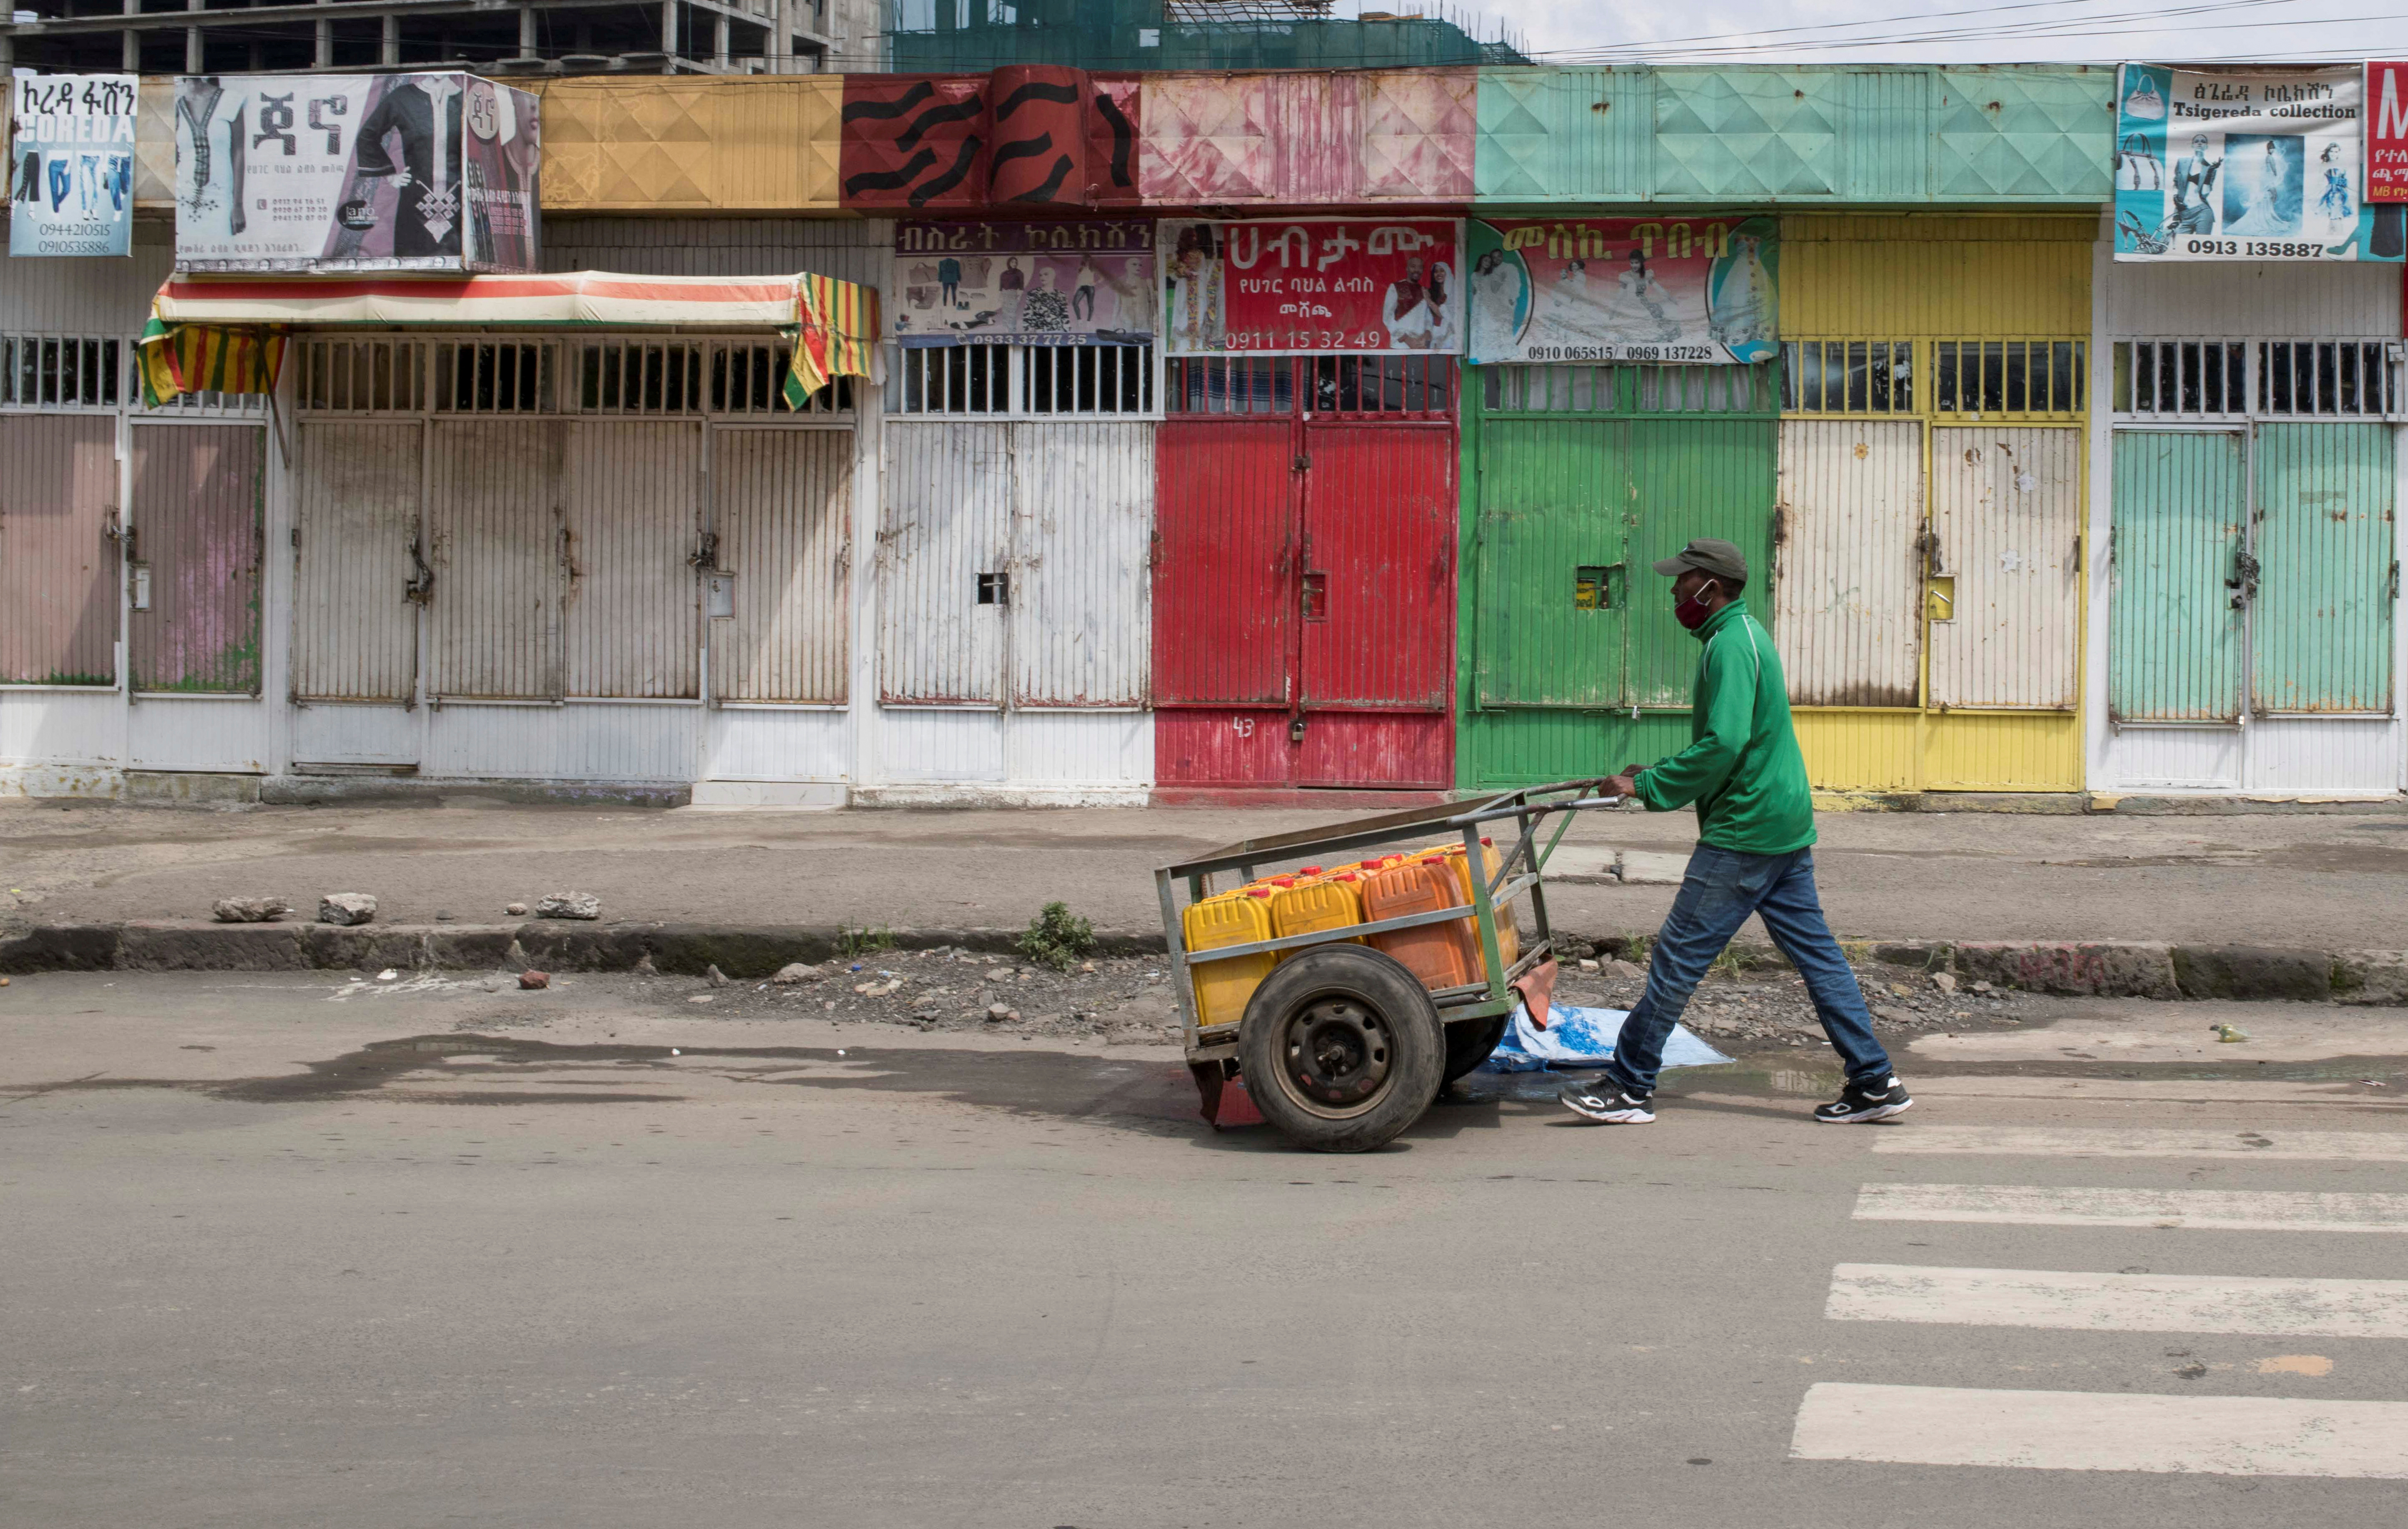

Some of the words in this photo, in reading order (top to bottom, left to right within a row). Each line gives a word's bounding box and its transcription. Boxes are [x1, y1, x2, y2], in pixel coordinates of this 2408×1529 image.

[2174, 102, 2261, 120] Tsigereda
[2270, 104, 2356, 118] collection
[17, 116, 135, 143] COREDA
[2373, 186, 2390, 197] MB
[39, 224, 110, 236] 0944210515
[899, 223, 1000, 250] ብስራት
[1025, 222, 1150, 248] ኮሌክሽን
[38, 240, 110, 253] 0910535886
[1630, 222, 1729, 258] ጥበብ
[2188, 240, 2237, 255] 0913
[2246, 242, 2323, 257] 135887
[1231, 226, 1434, 272] ሀብታሙ
[1239, 278, 1283, 294] የሀገር
[1291, 278, 1326, 292] ባህል
[1334, 277, 1374, 292] ልብስ
[1279, 301, 1332, 318] መሸጫ
[974, 335, 1013, 344] 0933
[1018, 335, 1038, 345] 37
[1043, 334, 1063, 345] 77
[1067, 334, 1086, 345] 25
[1225, 332, 1274, 349] 0911
[1288, 332, 1310, 348] 15
[1320, 331, 1345, 348] 32
[1354, 331, 1380, 348] 49
[1528, 347, 1561, 359] 0910
[1627, 347, 1659, 360] 0969
[1664, 346, 1712, 359] 137228
[1233, 717, 1254, 737] 43
